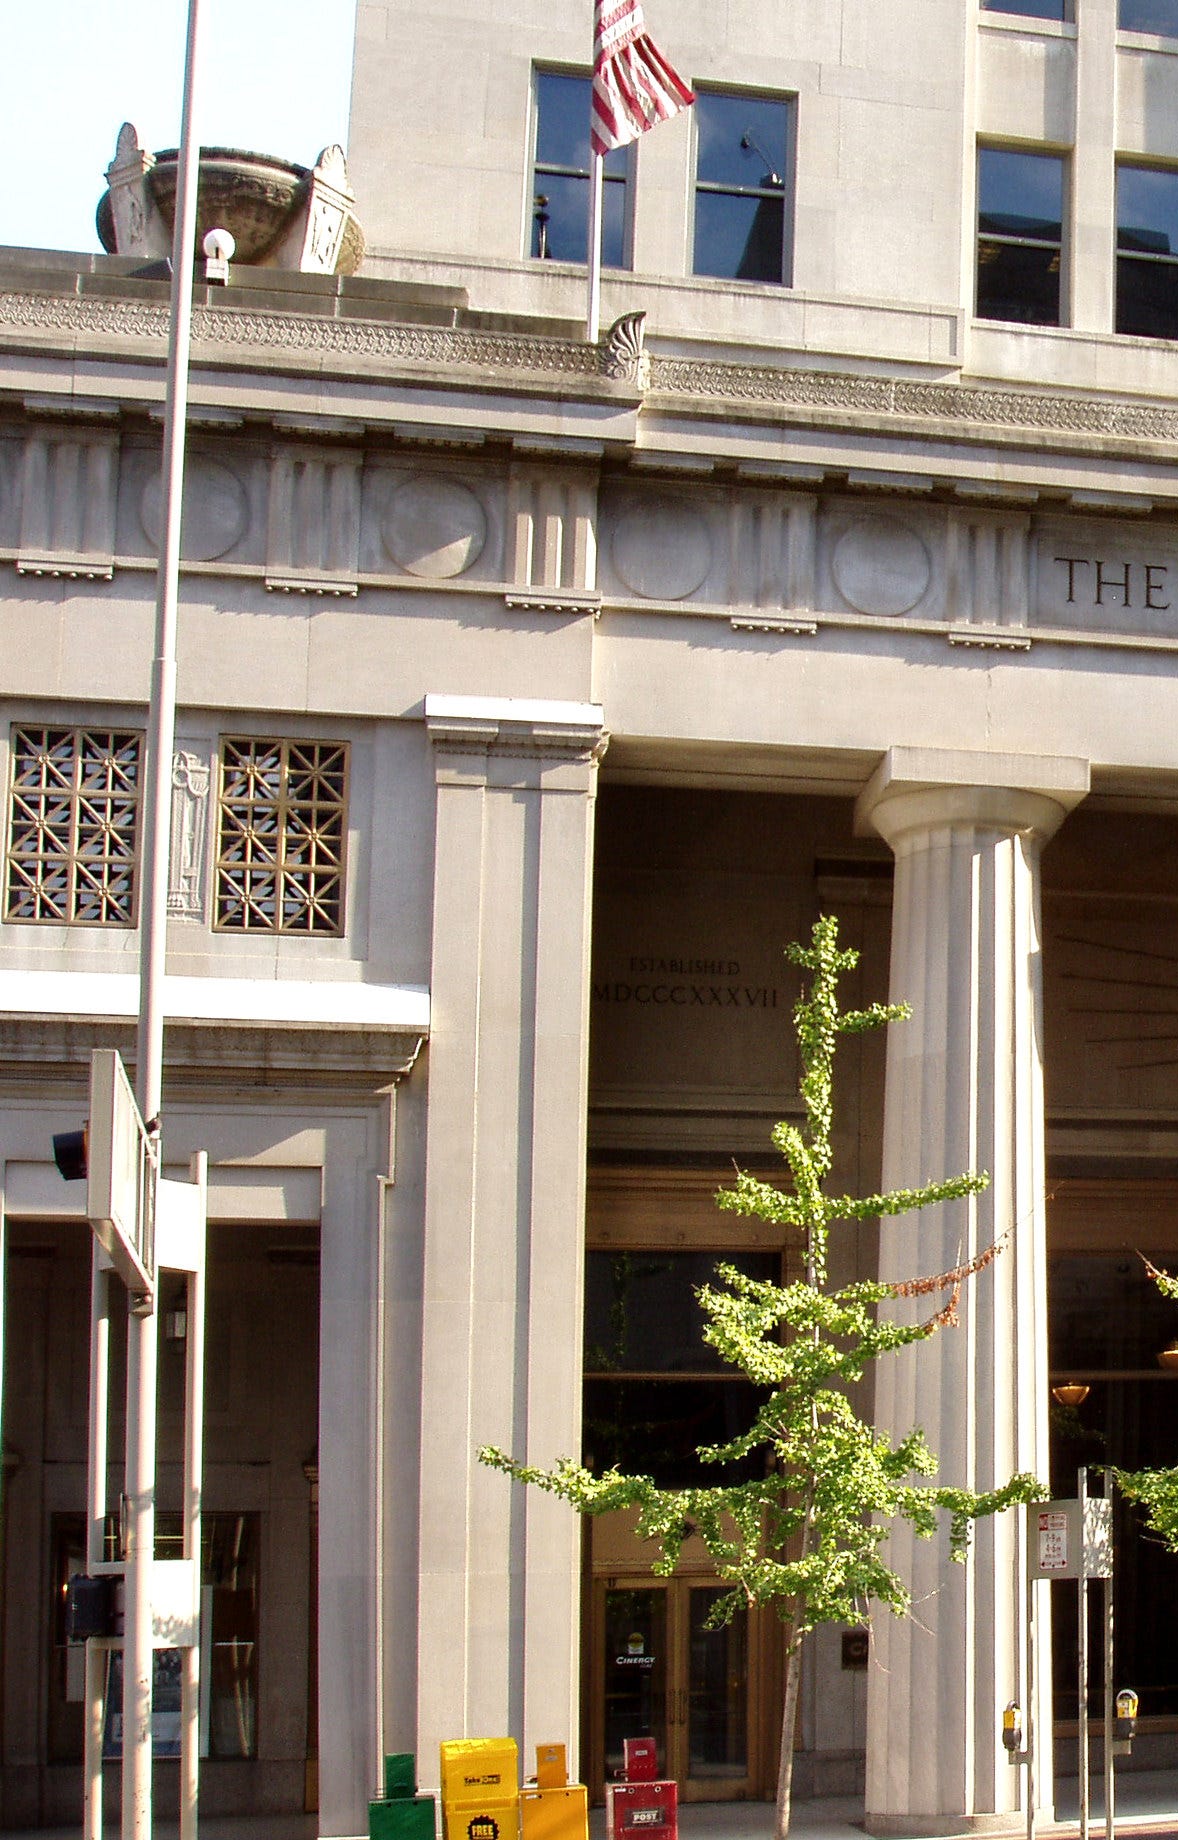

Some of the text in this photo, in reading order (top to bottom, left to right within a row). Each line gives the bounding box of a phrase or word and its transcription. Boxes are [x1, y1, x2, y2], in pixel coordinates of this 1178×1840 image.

[1054, 557, 1171, 610] THE
[630, 957, 741, 976] ESTABLISHED
[593, 982, 778, 1008] MDCCCXXXVII
[633, 1813, 657, 1821] POST
[472, 1825, 494, 1836] FREE
